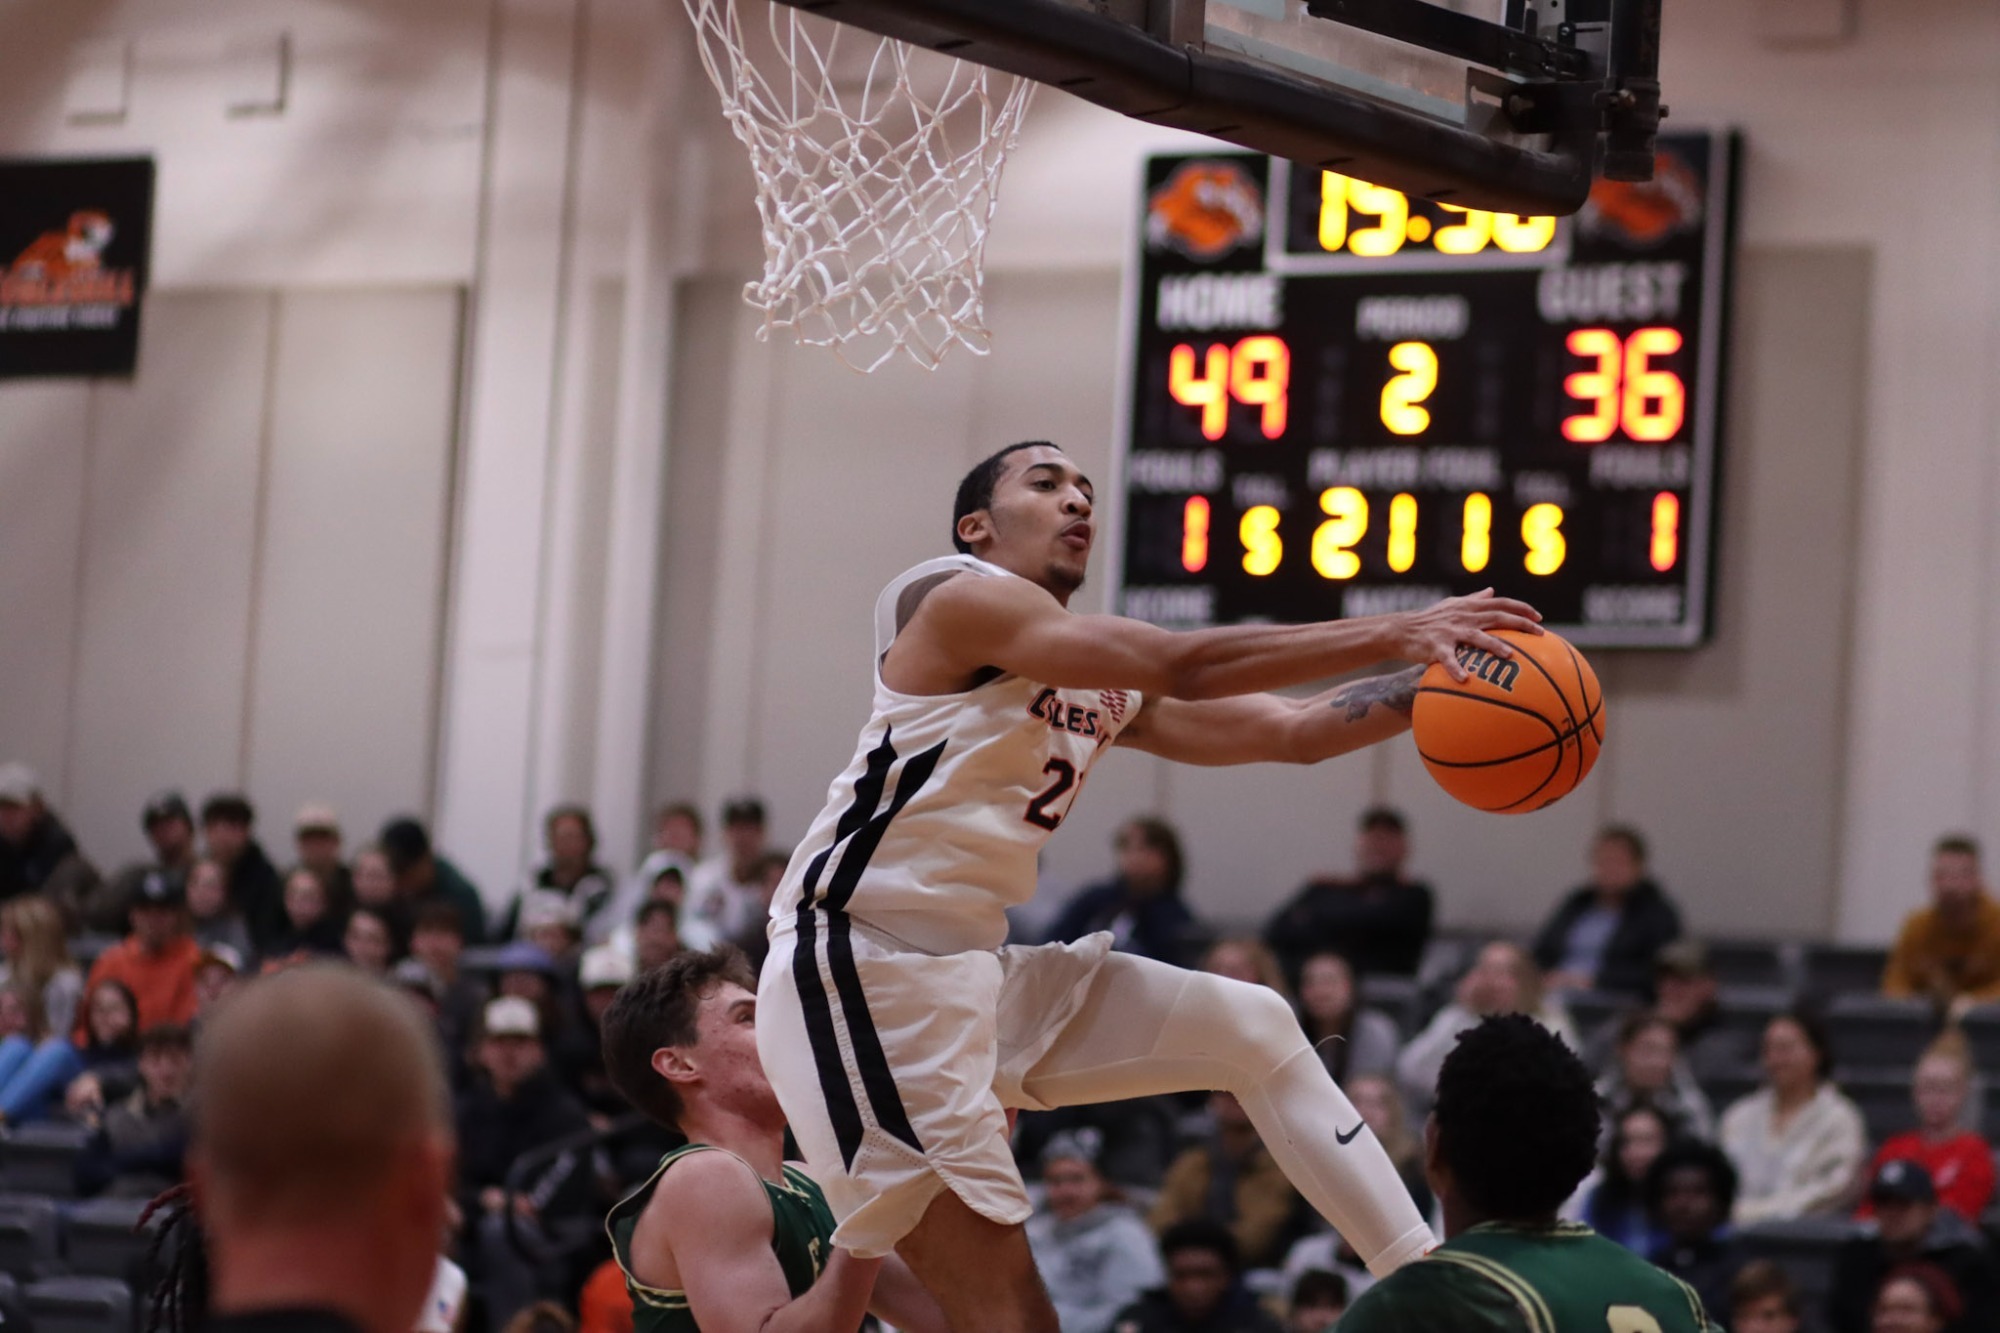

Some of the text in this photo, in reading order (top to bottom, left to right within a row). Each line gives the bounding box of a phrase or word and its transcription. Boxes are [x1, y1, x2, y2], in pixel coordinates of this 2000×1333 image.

[1169, 336, 1290, 440] 49
[1380, 341, 1438, 435] 2
[1561, 327, 1685, 442] 36
[1182, 496, 1210, 572] 1
[1239, 504, 1283, 576] 5
[1461, 492, 1492, 573] 1
[1521, 503, 1566, 576] 5
[1650, 491, 1679, 572] 1
